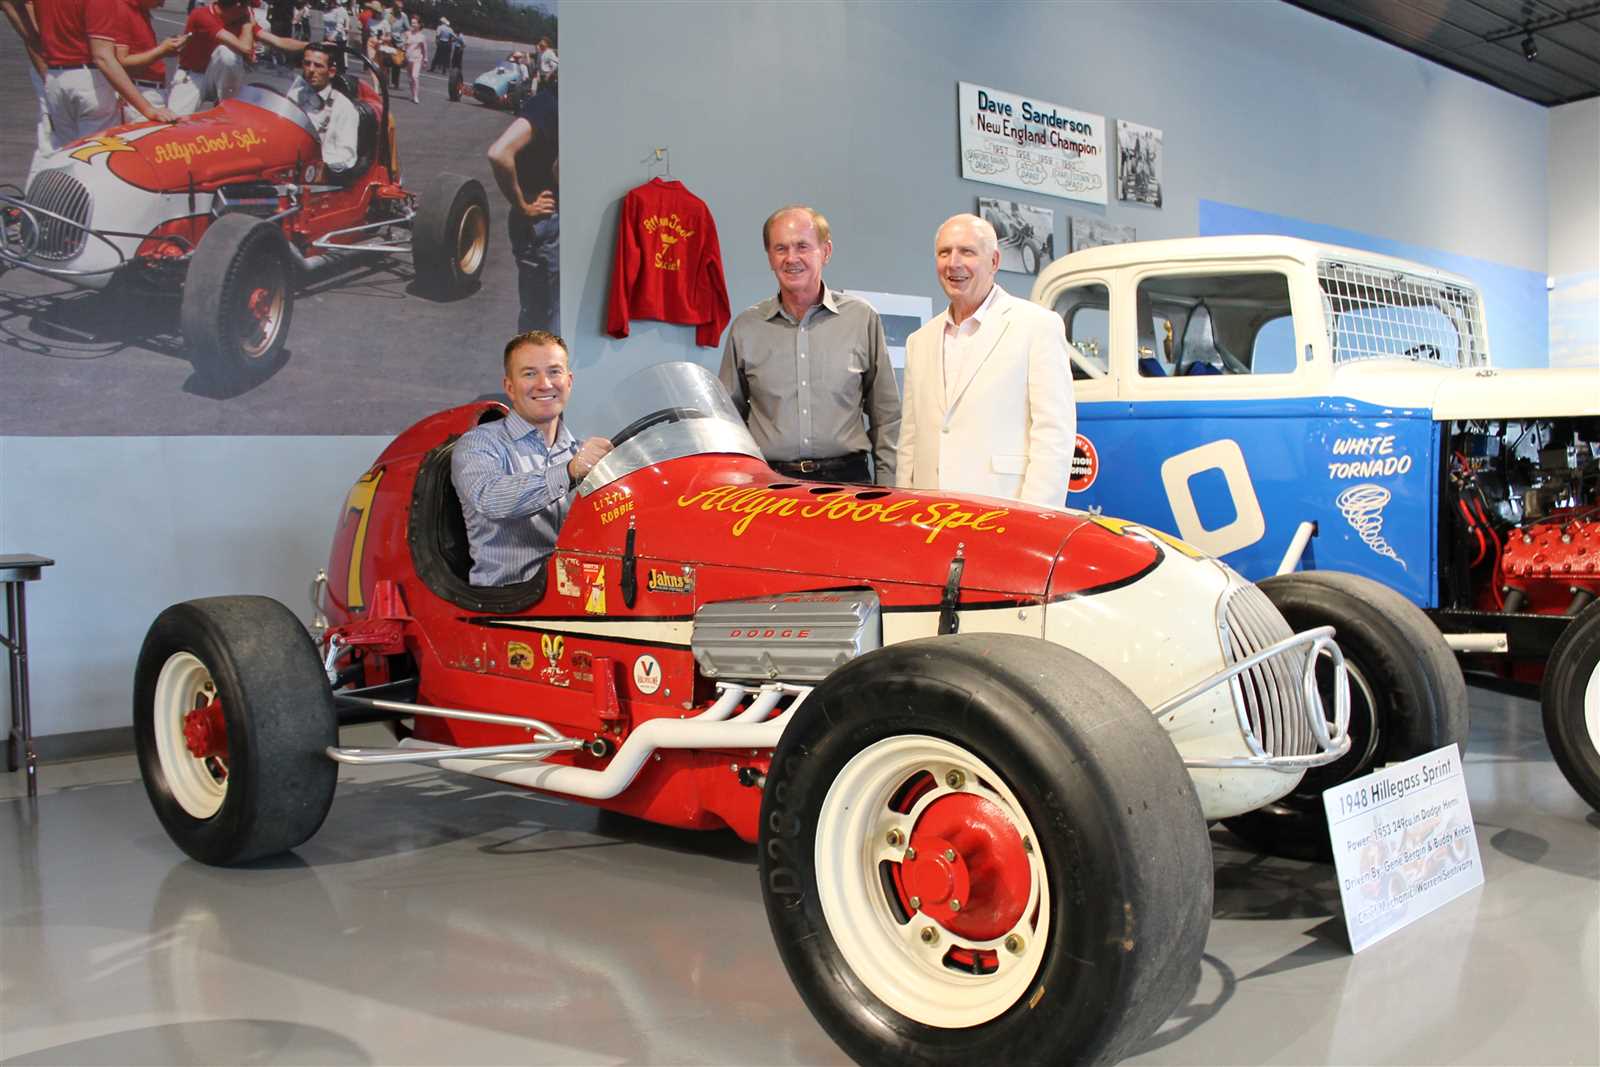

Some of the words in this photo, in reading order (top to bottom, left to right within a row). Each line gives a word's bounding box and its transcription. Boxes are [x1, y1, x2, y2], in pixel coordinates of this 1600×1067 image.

[978, 90, 1012, 117] Dave
[1021, 101, 1092, 136] Sanderson
[155, 142, 200, 165] Allyn
[196, 132, 234, 152] Tool
[232, 128, 266, 152] Spl.
[977, 114, 1000, 134] New
[1003, 119, 1047, 146] England
[1050, 131, 1097, 157] Champion
[1332, 435, 1396, 457] WHITE
[1327, 455, 1412, 480] TORNADO
[592, 489, 632, 512] LITTLE
[600, 500, 634, 525] ROBBIE
[678, 485, 799, 537] Allyn
[801, 492, 912, 523] Tool
[910, 502, 1010, 544] Spl.
[730, 629, 811, 639] DODGE
[1340, 788, 1368, 815] 1948
[1371, 773, 1421, 804] Hillegass
[1422, 759, 1451, 785] Sprint
[1421, 804, 1441, 820] Dodge
[1433, 833, 1453, 849] Buddy
